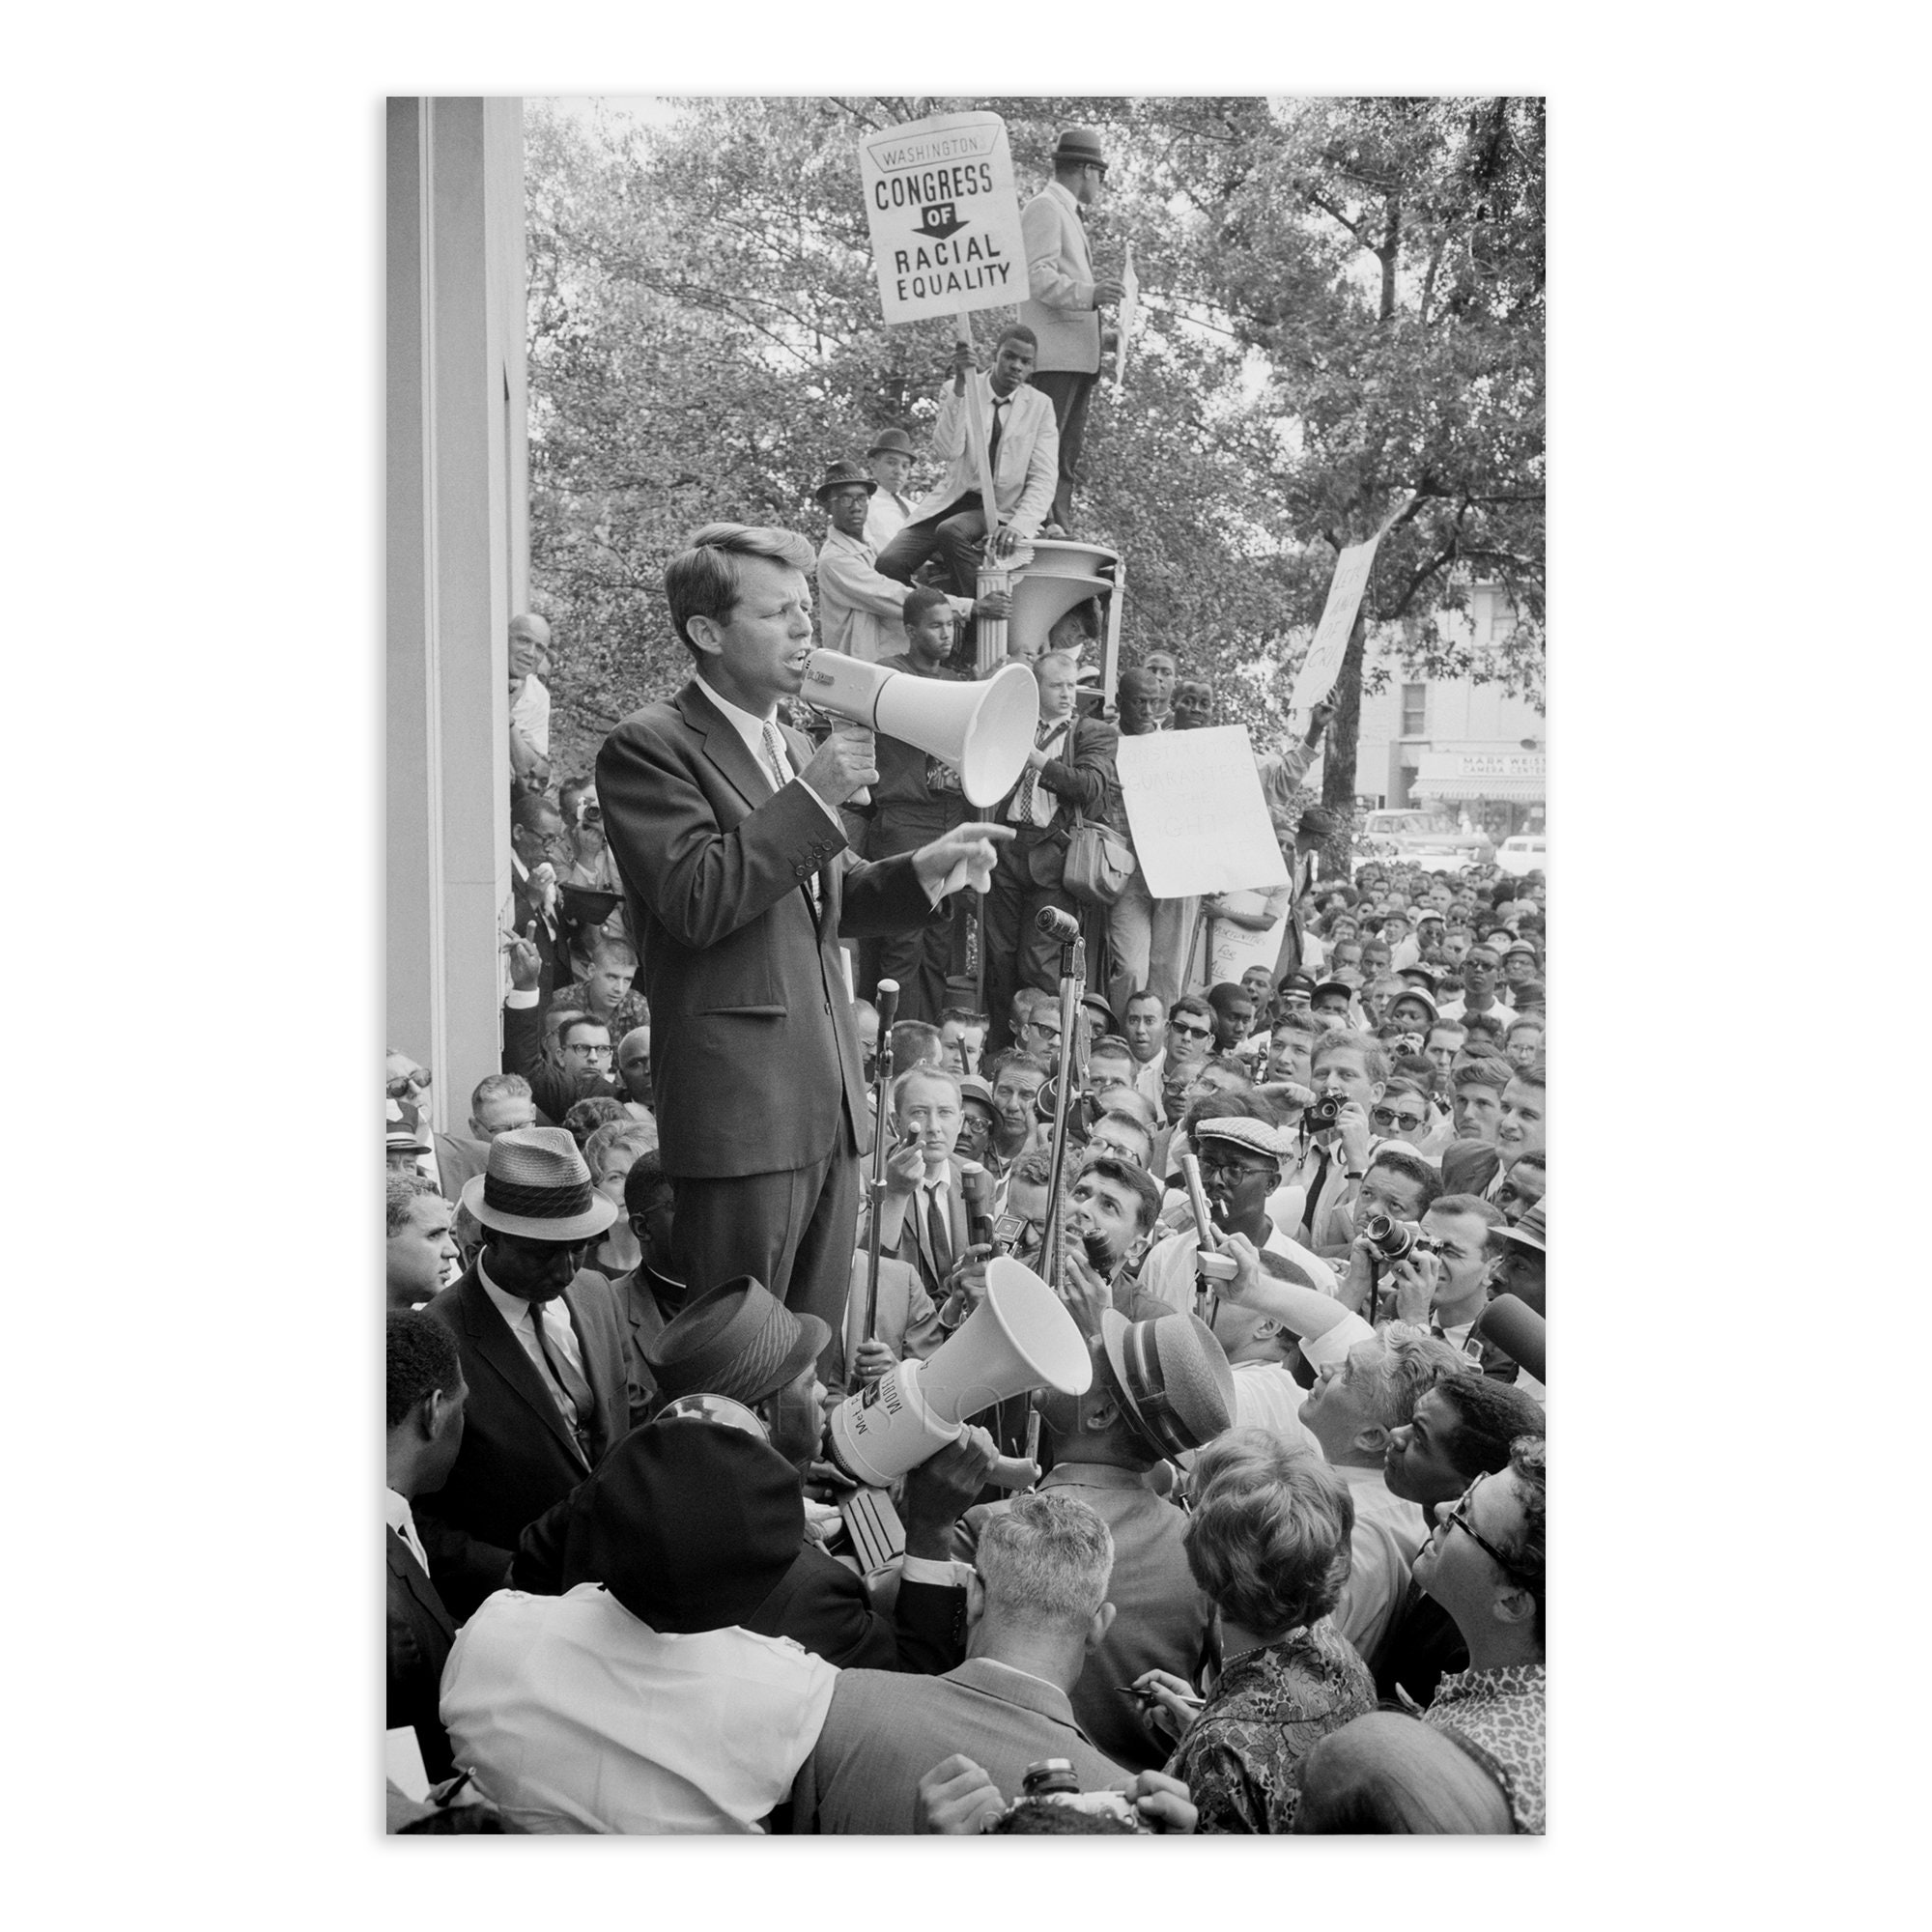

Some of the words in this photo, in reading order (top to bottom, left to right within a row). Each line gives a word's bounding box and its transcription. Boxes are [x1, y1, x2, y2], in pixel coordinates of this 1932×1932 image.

[882, 137, 978, 166] WASHINGTON
[874, 162, 993, 211] CONGRESS
[927, 207, 952, 227] OF
[895, 234, 1001, 274] RACIAL
[896, 262, 1011, 301] EQUALITY
[1127, 762, 1254, 792] GUARANTEES
[881, 1374, 903, 1416] MODEL
